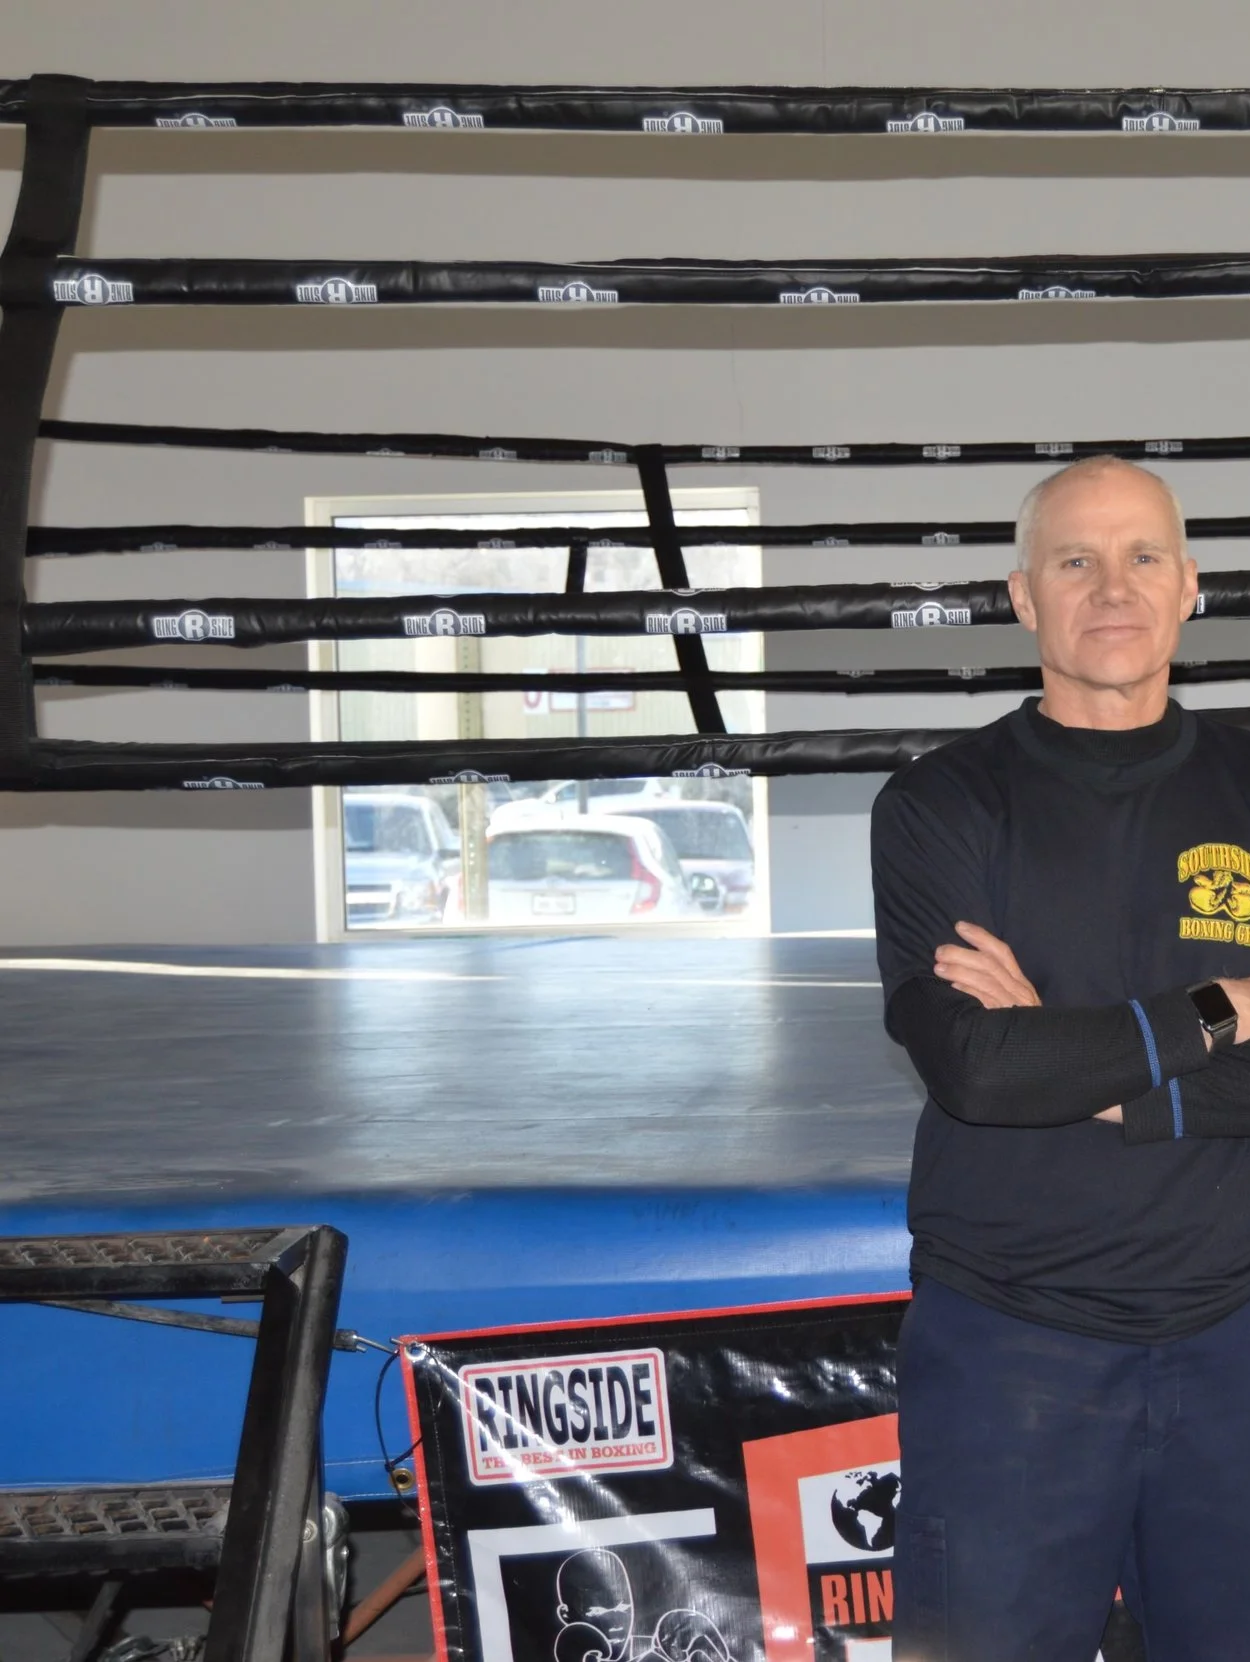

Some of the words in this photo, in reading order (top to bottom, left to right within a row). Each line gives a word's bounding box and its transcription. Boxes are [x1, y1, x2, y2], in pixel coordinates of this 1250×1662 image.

[55, 282, 76, 300] SIDE
[84, 279, 102, 303] R
[110, 283, 132, 301] RING
[298, 286, 320, 302] SIDE
[328, 283, 347, 303] R
[354, 286, 376, 302] RING
[156, 619, 177, 636] RING
[184, 614, 204, 638] R
[405, 618, 427, 635] RING
[435, 613, 455, 635] R
[461, 617, 483, 633] SIDE
[647, 616, 669, 632] RING
[676, 613, 696, 634] R
[703, 616, 725, 631] SIDE
[893, 613, 914, 627] RING
[922, 607, 941, 626] R
[948, 611, 969, 624] SIDE
[1179, 917, 1234, 942] BOXING
[475, 1363, 656, 1452] RINGSIDE
[569, 1446, 587, 1460] IN
[591, 1442, 657, 1460] BOXING
[821, 1569, 894, 1627] RIN
